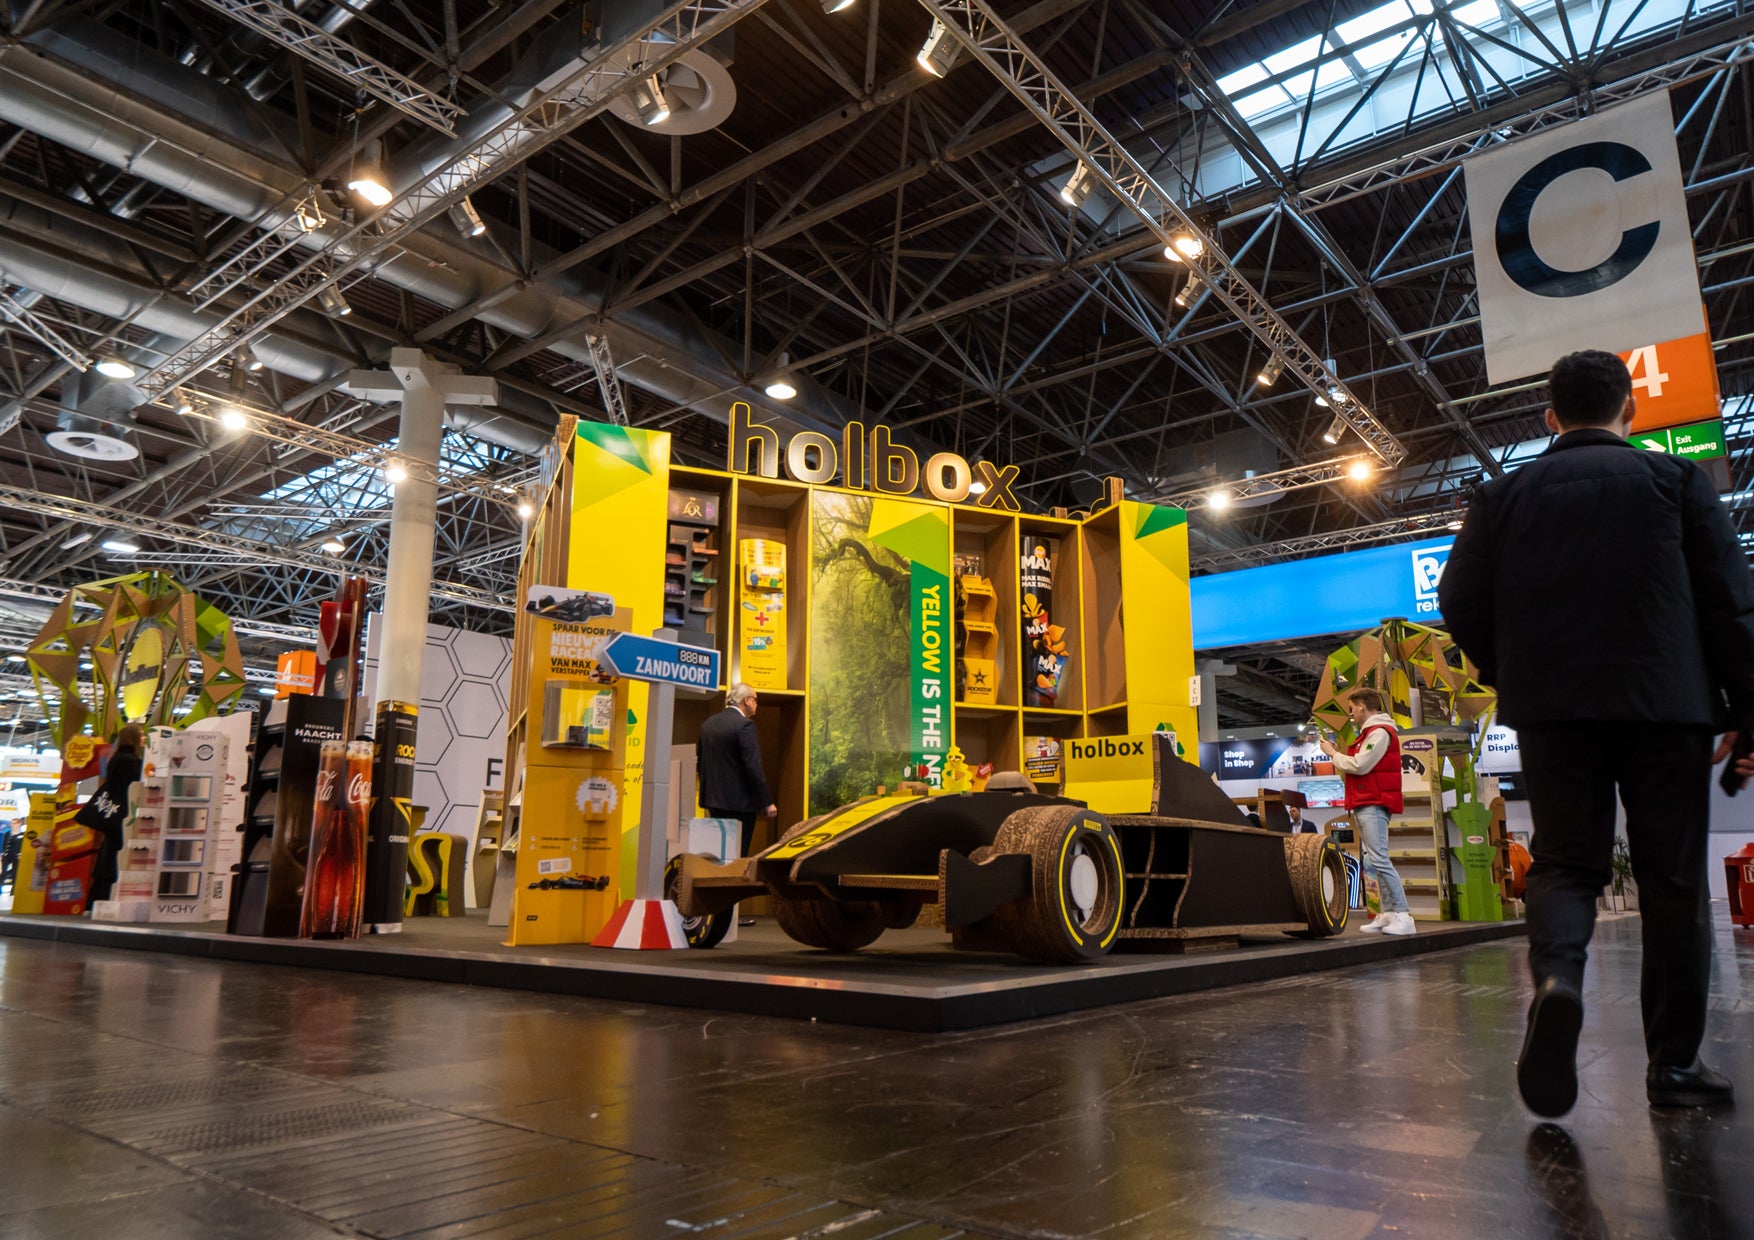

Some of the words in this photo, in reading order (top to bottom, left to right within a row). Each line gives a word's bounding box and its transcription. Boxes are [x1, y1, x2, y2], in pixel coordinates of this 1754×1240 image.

[1495, 141, 1661, 298] C
[1626, 344, 1669, 398] 4
[1675, 435, 1692, 444] Exit
[1677, 442, 1717, 454] Ausgang
[727, 401, 1021, 512] holbox
[552, 623, 579, 633] SPAAR
[580, 625, 605, 635] VOOR
[922, 585, 941, 673] YELLOW
[1026, 622, 1048, 636] MAX
[550, 646, 597, 660] RACEA
[679, 649, 698, 664] 888
[698, 654, 710, 666] KM
[551, 658, 570, 667] VAN
[571, 659, 591, 669] MAX
[635, 656, 712, 685] ZANDVOORT
[1038, 655, 1062, 674] MAX
[922, 678, 941, 699] IS
[922, 704, 941, 748] THE
[294, 728, 342, 740] HAACHT
[1487, 734, 1506, 742] RRP
[1072, 738, 1144, 759] holbox
[1224, 750, 1245, 759] Shop
[1233, 759, 1255, 768] Shop
[486, 758, 503, 787] F
[158, 904, 197, 914] VICHY
